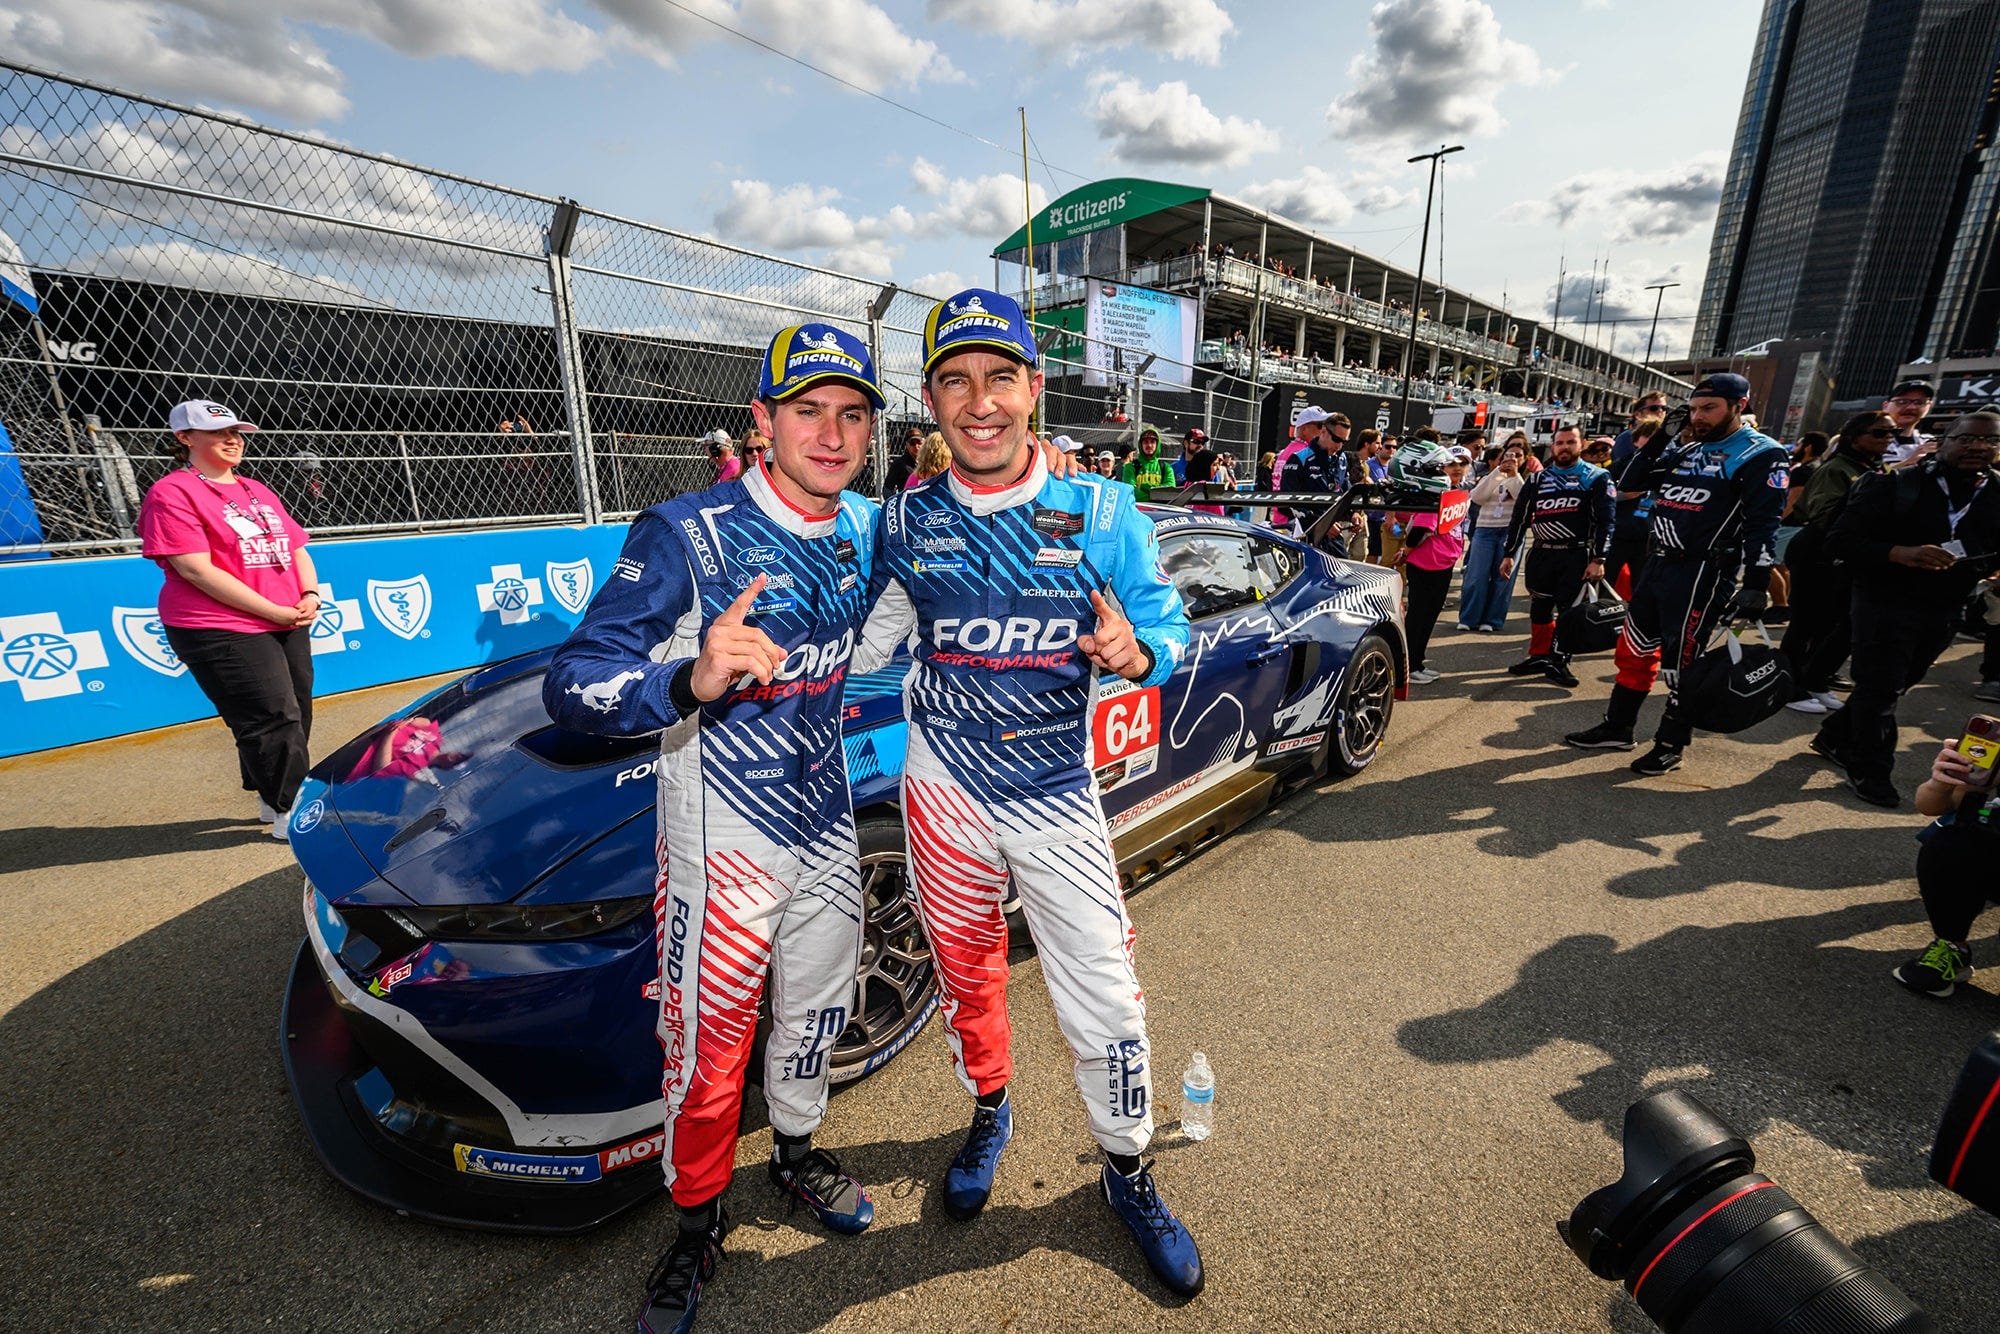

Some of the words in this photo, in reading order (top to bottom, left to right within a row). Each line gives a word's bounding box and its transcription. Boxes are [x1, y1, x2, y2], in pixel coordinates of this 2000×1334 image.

[1064, 191, 1126, 224] Citizens
[1066, 224, 1093, 236] TRACKSIDE
[1093, 219, 1111, 230] SUITES
[1118, 288, 1151, 302] UNOFFICIAL
[1153, 294, 1176, 305] RESULTS
[1107, 311, 1135, 321] ALEXANDER
[1136, 315, 1148, 323] SIMS
[1108, 302, 1121, 310] MIKE
[1122, 304, 1156, 315] ROCKENFELLER
[938, 317, 1010, 341] MICHELIN
[1107, 319, 1124, 328] MARCO
[1110, 327, 1129, 336] LAURIN
[1129, 331, 1152, 339] HEINRICH
[1110, 336, 1128, 344] AARON
[788, 354, 863, 374] MICHELIN
[1230, 493, 1341, 501] MUSTA
[1660, 483, 1711, 504] FORD
[1099, 487, 1119, 532] sparco
[1536, 497, 1581, 510] FORD
[887, 496, 898, 536] sparco
[924, 511, 954, 527] Ford
[1439, 503, 1465, 525] FORD
[680, 518, 719, 577] sparco
[924, 537, 967, 546] Multimatic
[243, 551, 292, 565] SERVIES
[618, 556, 646, 569] TANG
[747, 549, 777, 563] Ford
[612, 563, 642, 582] T3
[1022, 588, 1081, 598] SCHAEFFLER
[757, 602, 792, 612] MICHELIN
[933, 617, 1078, 654] FORD
[927, 651, 1073, 671] PERFORMANCE
[727, 665, 847, 705] PERFORMNC
[1099, 682, 1133, 698] eather
[926, 714, 957, 730] sparco
[1017, 720, 1079, 738] ROCKENFELLER
[1105, 694, 1152, 756] 64
[1278, 739, 1300, 751] GTD
[1300, 734, 1323, 745] PRO
[745, 767, 784, 779] sparco
[1113, 772, 1203, 828] PERFORMANCE
[667, 895, 691, 985] FORD
[388, 968, 409, 984] TOW
[870, 999, 938, 1069] MICHELIN
[606, 1134, 665, 1168] MOT
[492, 1161, 586, 1176] MICHELIN
